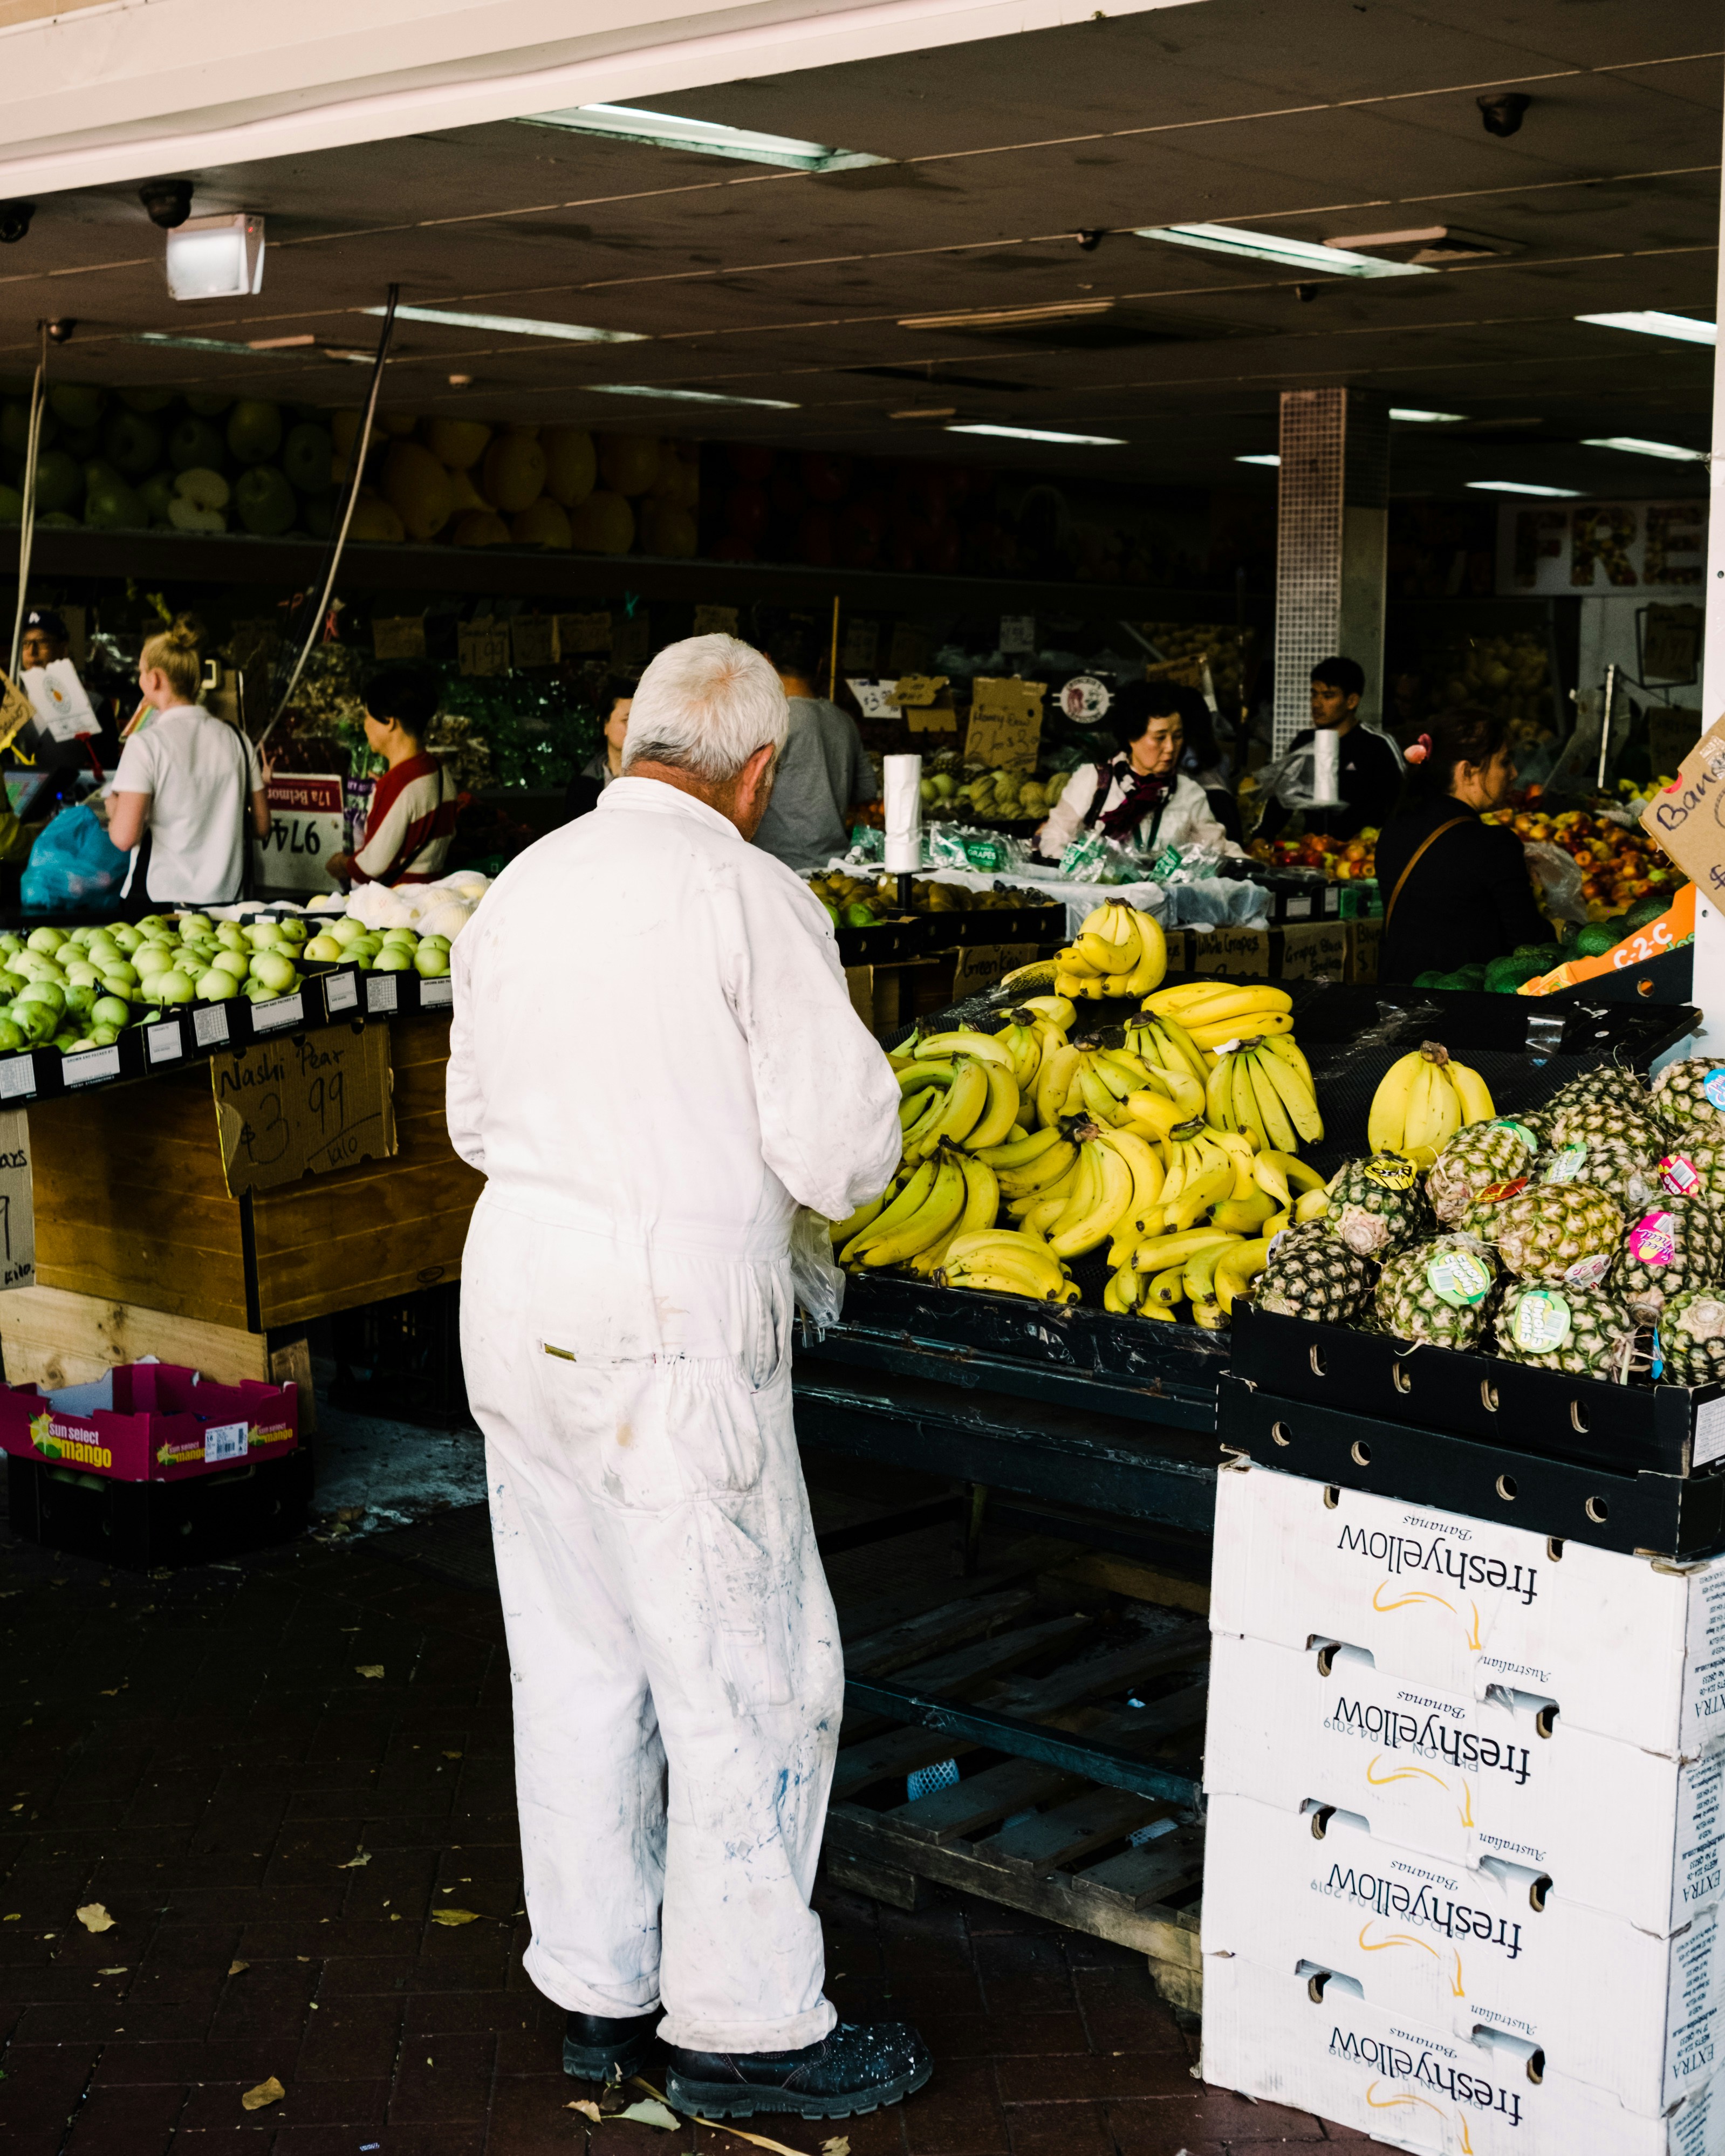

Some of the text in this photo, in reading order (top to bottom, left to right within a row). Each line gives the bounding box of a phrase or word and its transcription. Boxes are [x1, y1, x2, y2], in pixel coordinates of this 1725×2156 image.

[967, 848, 997, 860] GRAPES
[1197, 932, 1223, 956] White
[1223, 932, 1259, 957] Grapes
[1613, 923, 1673, 969] C-2-C
[963, 949, 997, 978] Green
[220, 1041, 344, 1098] Nashi Pear
[1444, 1254, 1474, 1295] CHOMP
[1531, 1299, 1546, 1348] CHOMP
[48, 1422, 99, 1446] sun select
[264, 1428, 293, 1444] mango
[269, 1422, 286, 1433] select
[61, 1440, 112, 1469] mango
[180, 1441, 200, 1453] select
[1402, 1514, 1473, 1541] Bananas
[1337, 1524, 1538, 1606] freshyellow
[1477, 1655, 1552, 1684] Australian
[1397, 1689, 1466, 1719] Bananas
[1333, 1696, 1532, 1785] freshyellow
[1412, 1742, 1437, 1760] ON
[1477, 1831, 1548, 1862] Australian
[1389, 1859, 1459, 1891] Bananas
[1682, 1869, 1722, 1903] EXTRA
[1325, 1863, 1523, 1959] freshyellow
[1400, 1911, 1425, 1926] ON
[1470, 2003, 1537, 2036] Australian
[1388, 2025, 1457, 2058] Bananas
[1330, 2026, 1524, 2126] freshyellow
[1672, 2043, 1715, 2080] EXTRA
